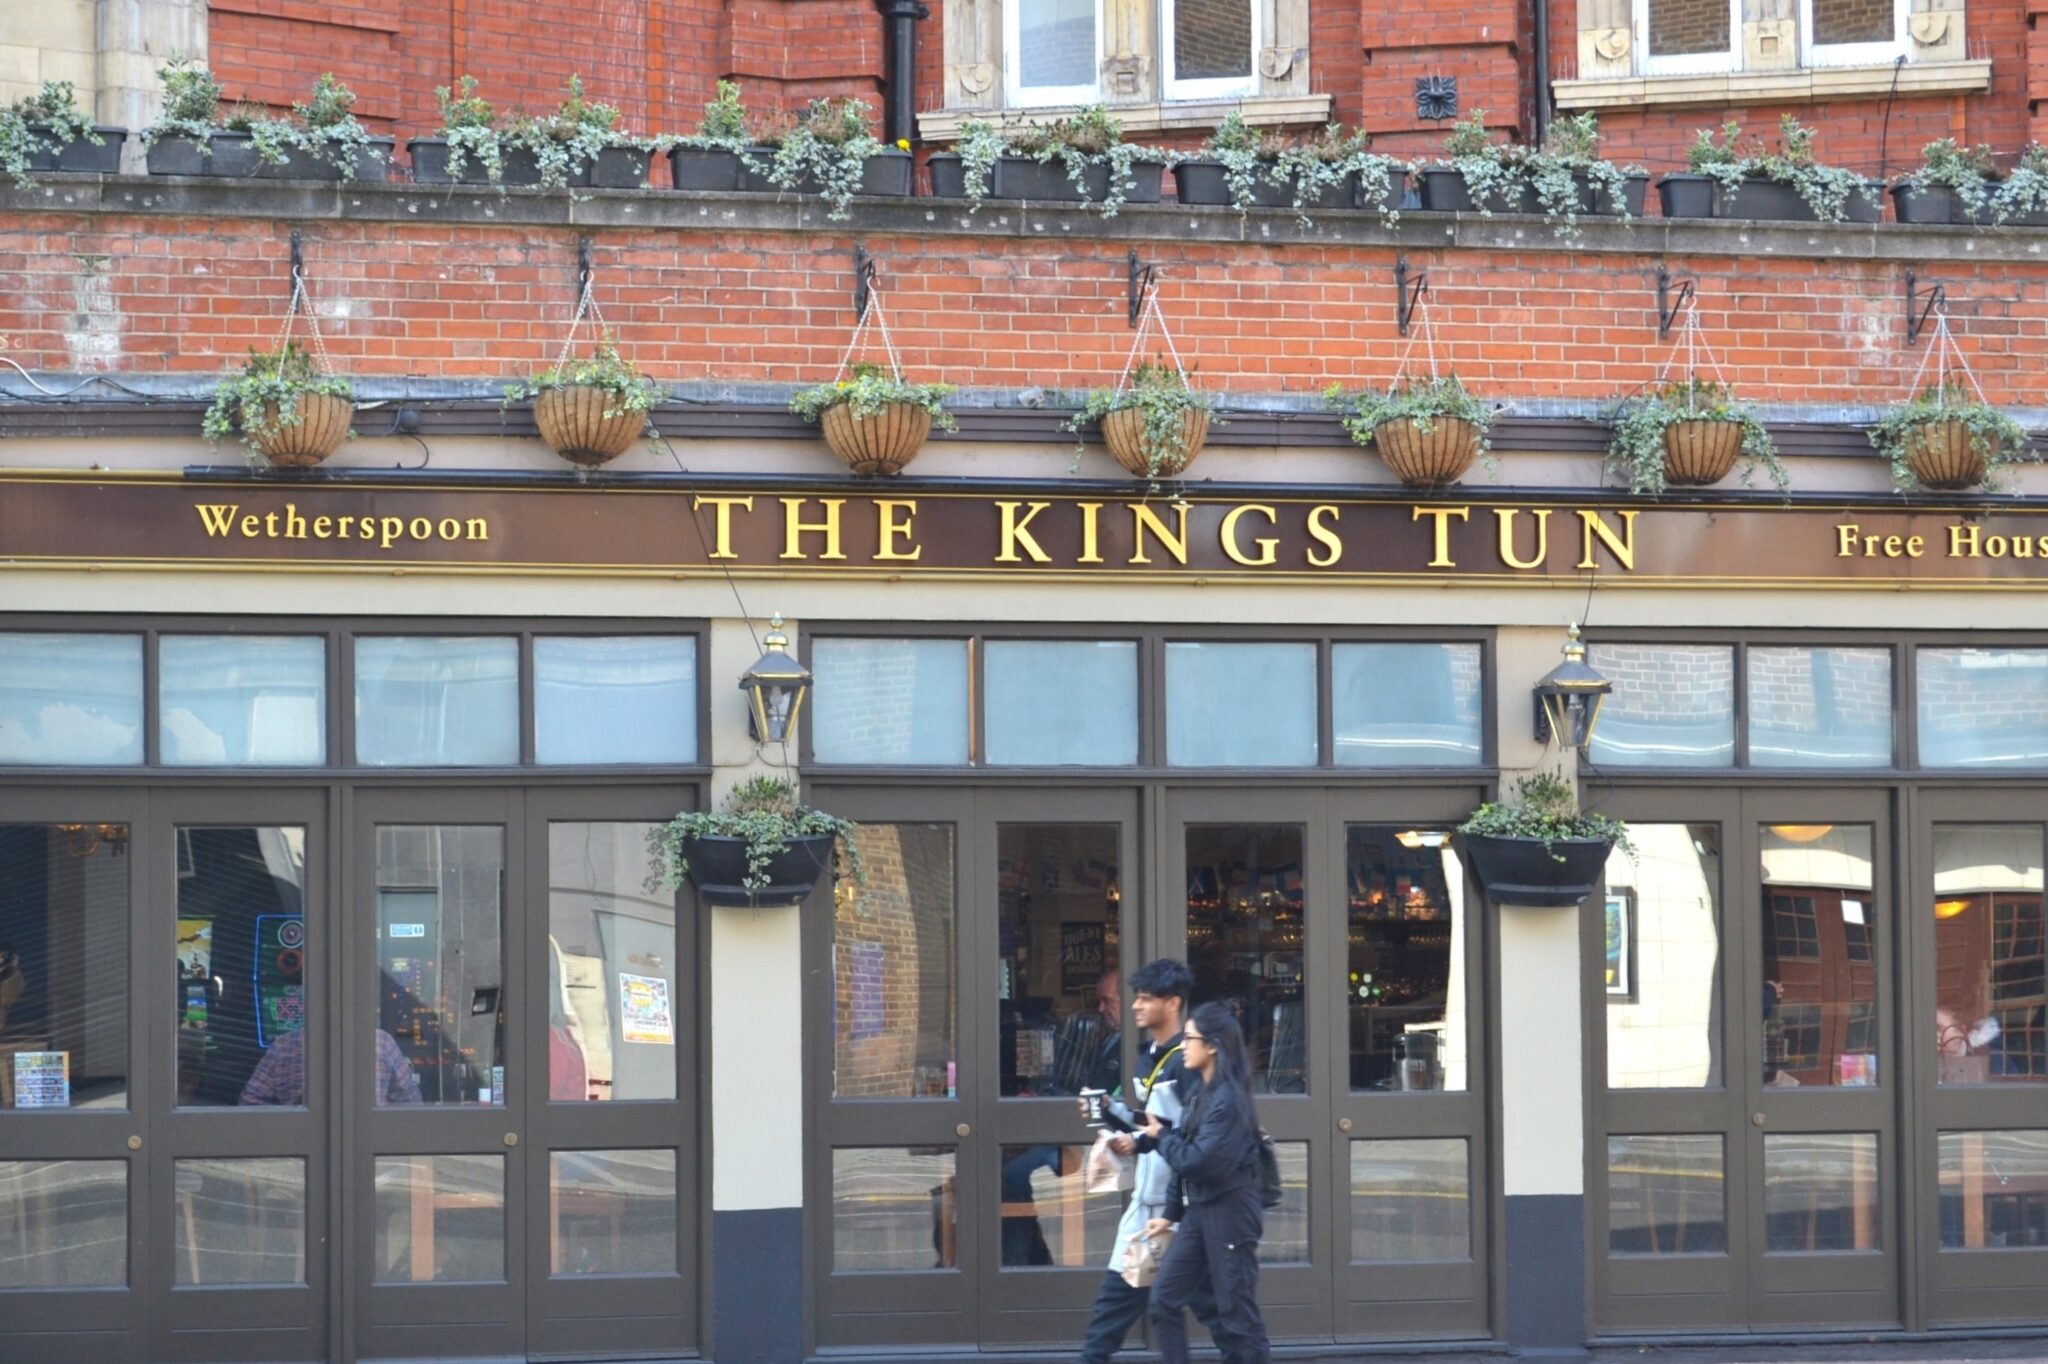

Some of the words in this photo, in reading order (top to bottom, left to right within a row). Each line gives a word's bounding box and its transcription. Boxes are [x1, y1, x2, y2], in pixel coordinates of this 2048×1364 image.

[195, 503, 489, 548] Wetherspoon
[693, 495, 922, 560] THE
[994, 501, 1343, 567] KINGS
[1412, 506, 1641, 570] TUN
[1837, 524, 1925, 558] Free
